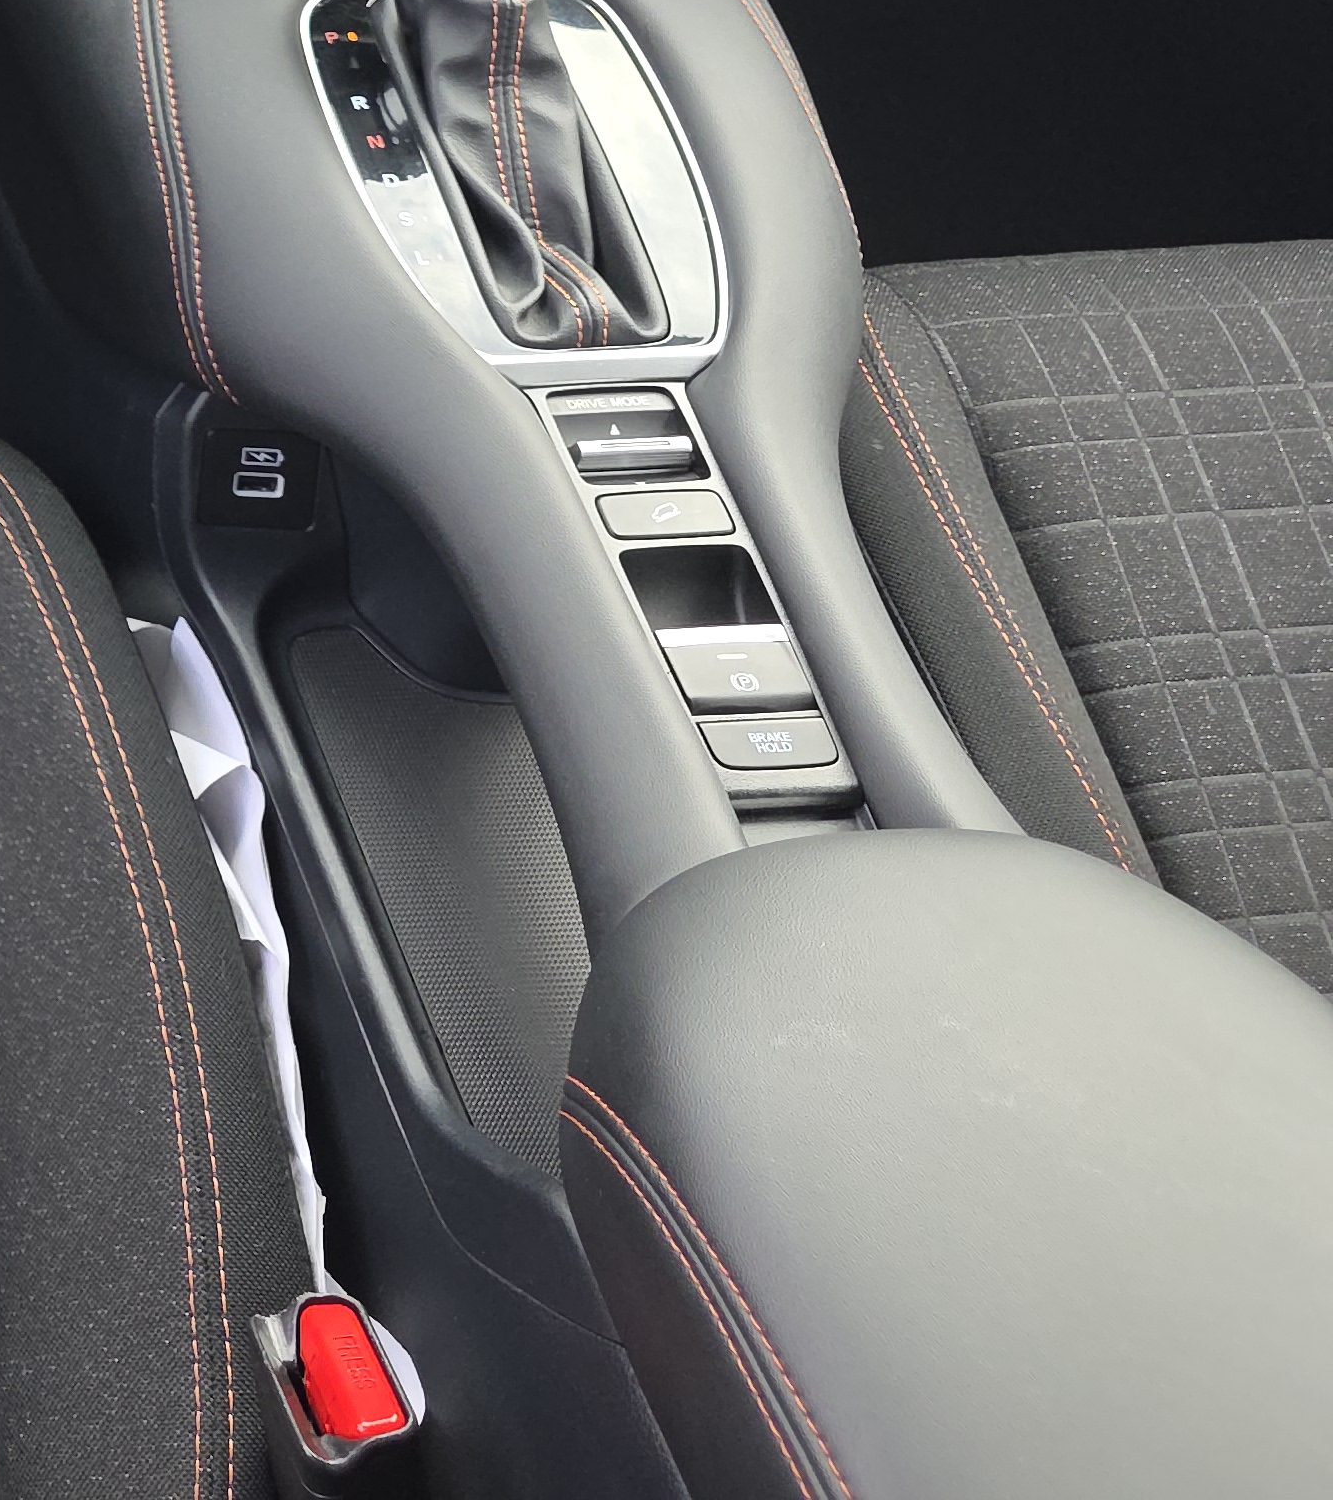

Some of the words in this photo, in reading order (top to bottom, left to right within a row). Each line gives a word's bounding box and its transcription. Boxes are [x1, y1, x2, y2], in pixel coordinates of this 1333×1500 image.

[324, 30, 340, 44] P
[350, 95, 370, 111] R
[366, 134, 386, 149] N
[382, 172, 400, 188] D
[398, 211, 414, 227] S
[414, 250, 430, 266] L
[565, 397, 608, 411] DRIVE
[610, 395, 651, 409] MODE
[747, 731, 793, 744] BRAKE
[756, 741, 793, 754] HOLD
[333, 1333, 377, 1391] PRESS
